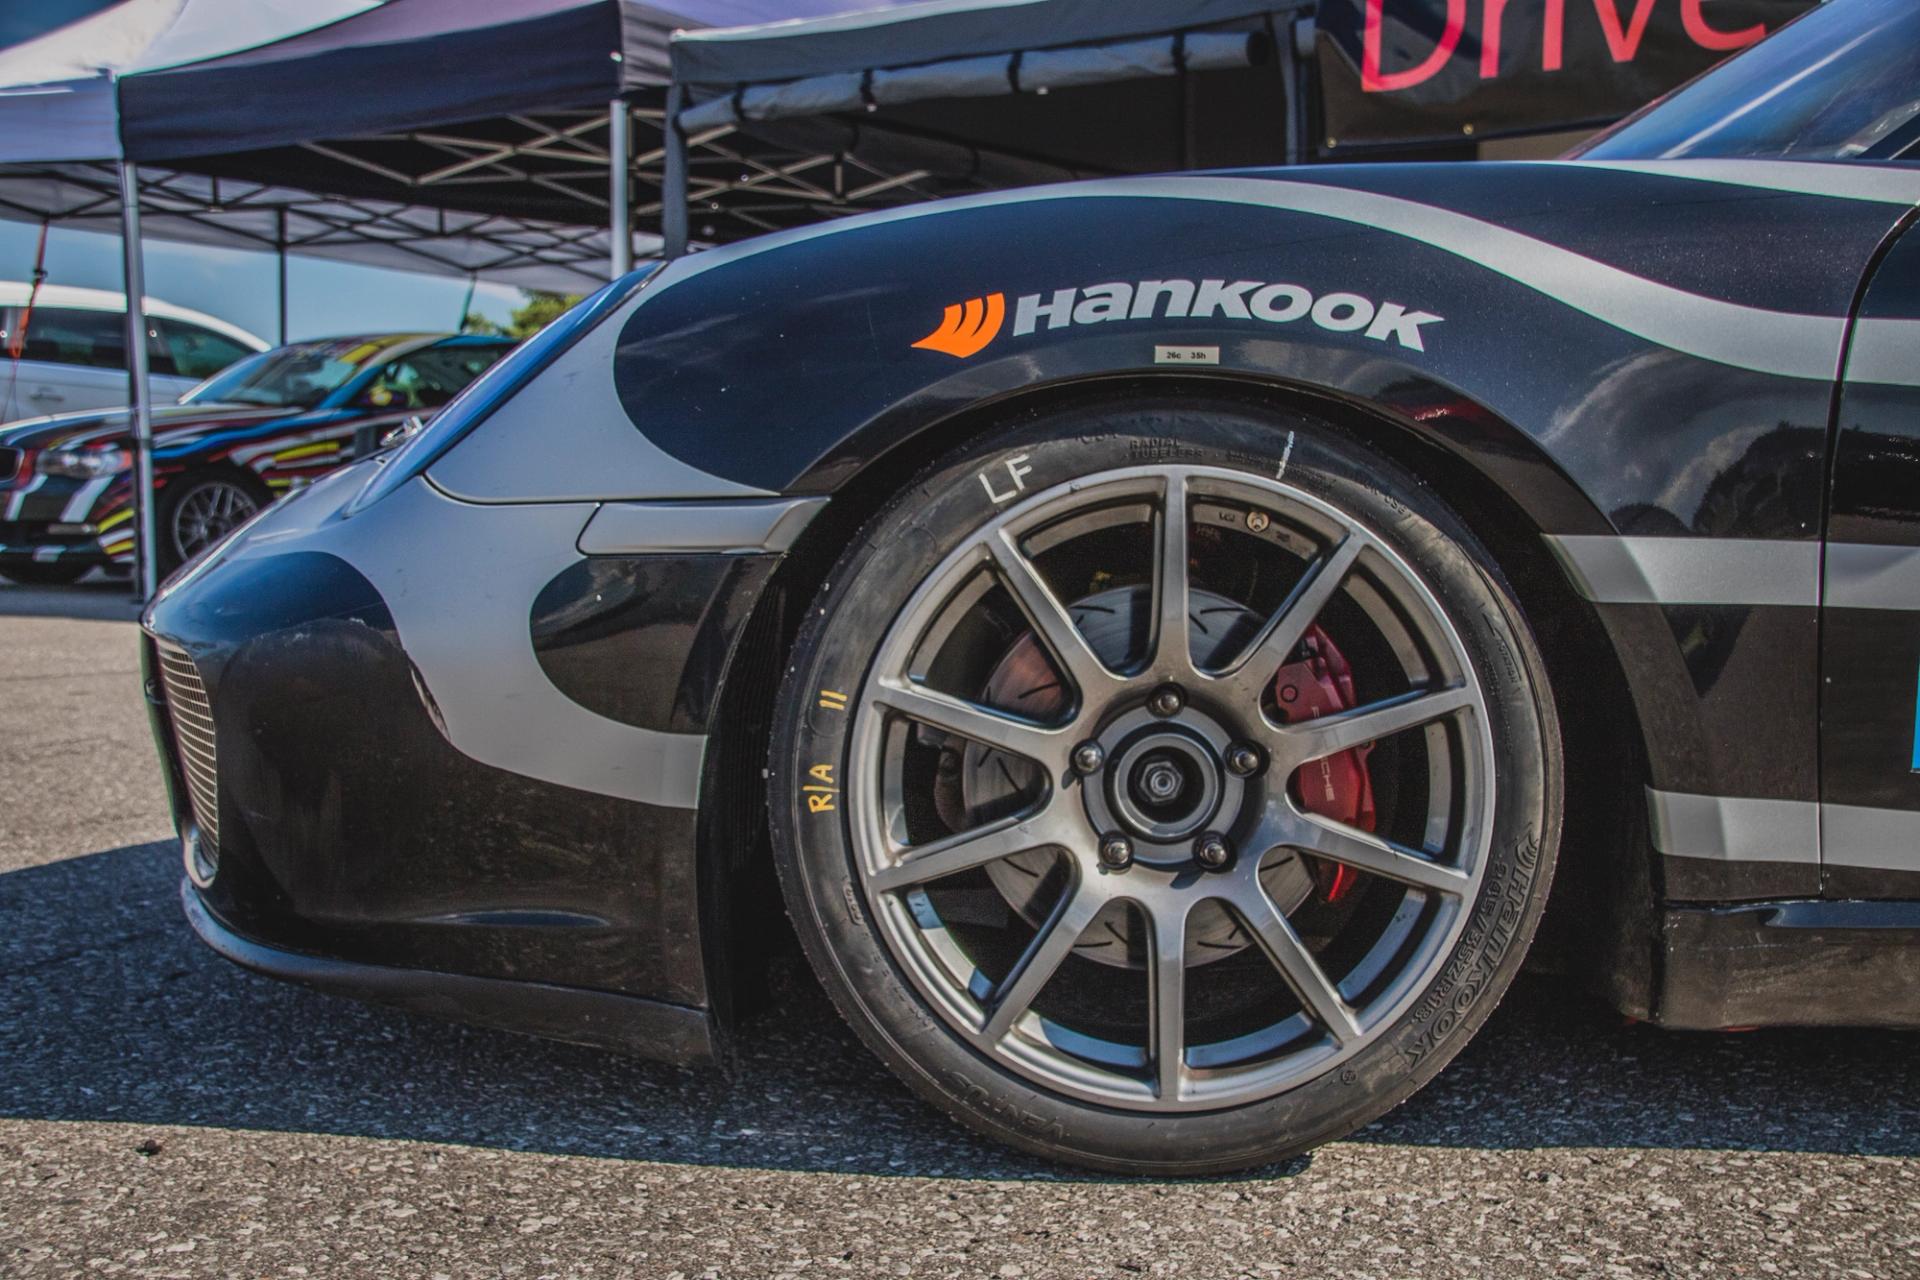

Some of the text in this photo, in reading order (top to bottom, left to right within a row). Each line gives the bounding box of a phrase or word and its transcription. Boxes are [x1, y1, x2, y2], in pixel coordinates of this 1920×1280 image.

[1190, 351, 1207, 360] 35h
[1129, 438, 1182, 450] RADIAL
[978, 454, 1033, 504] LF
